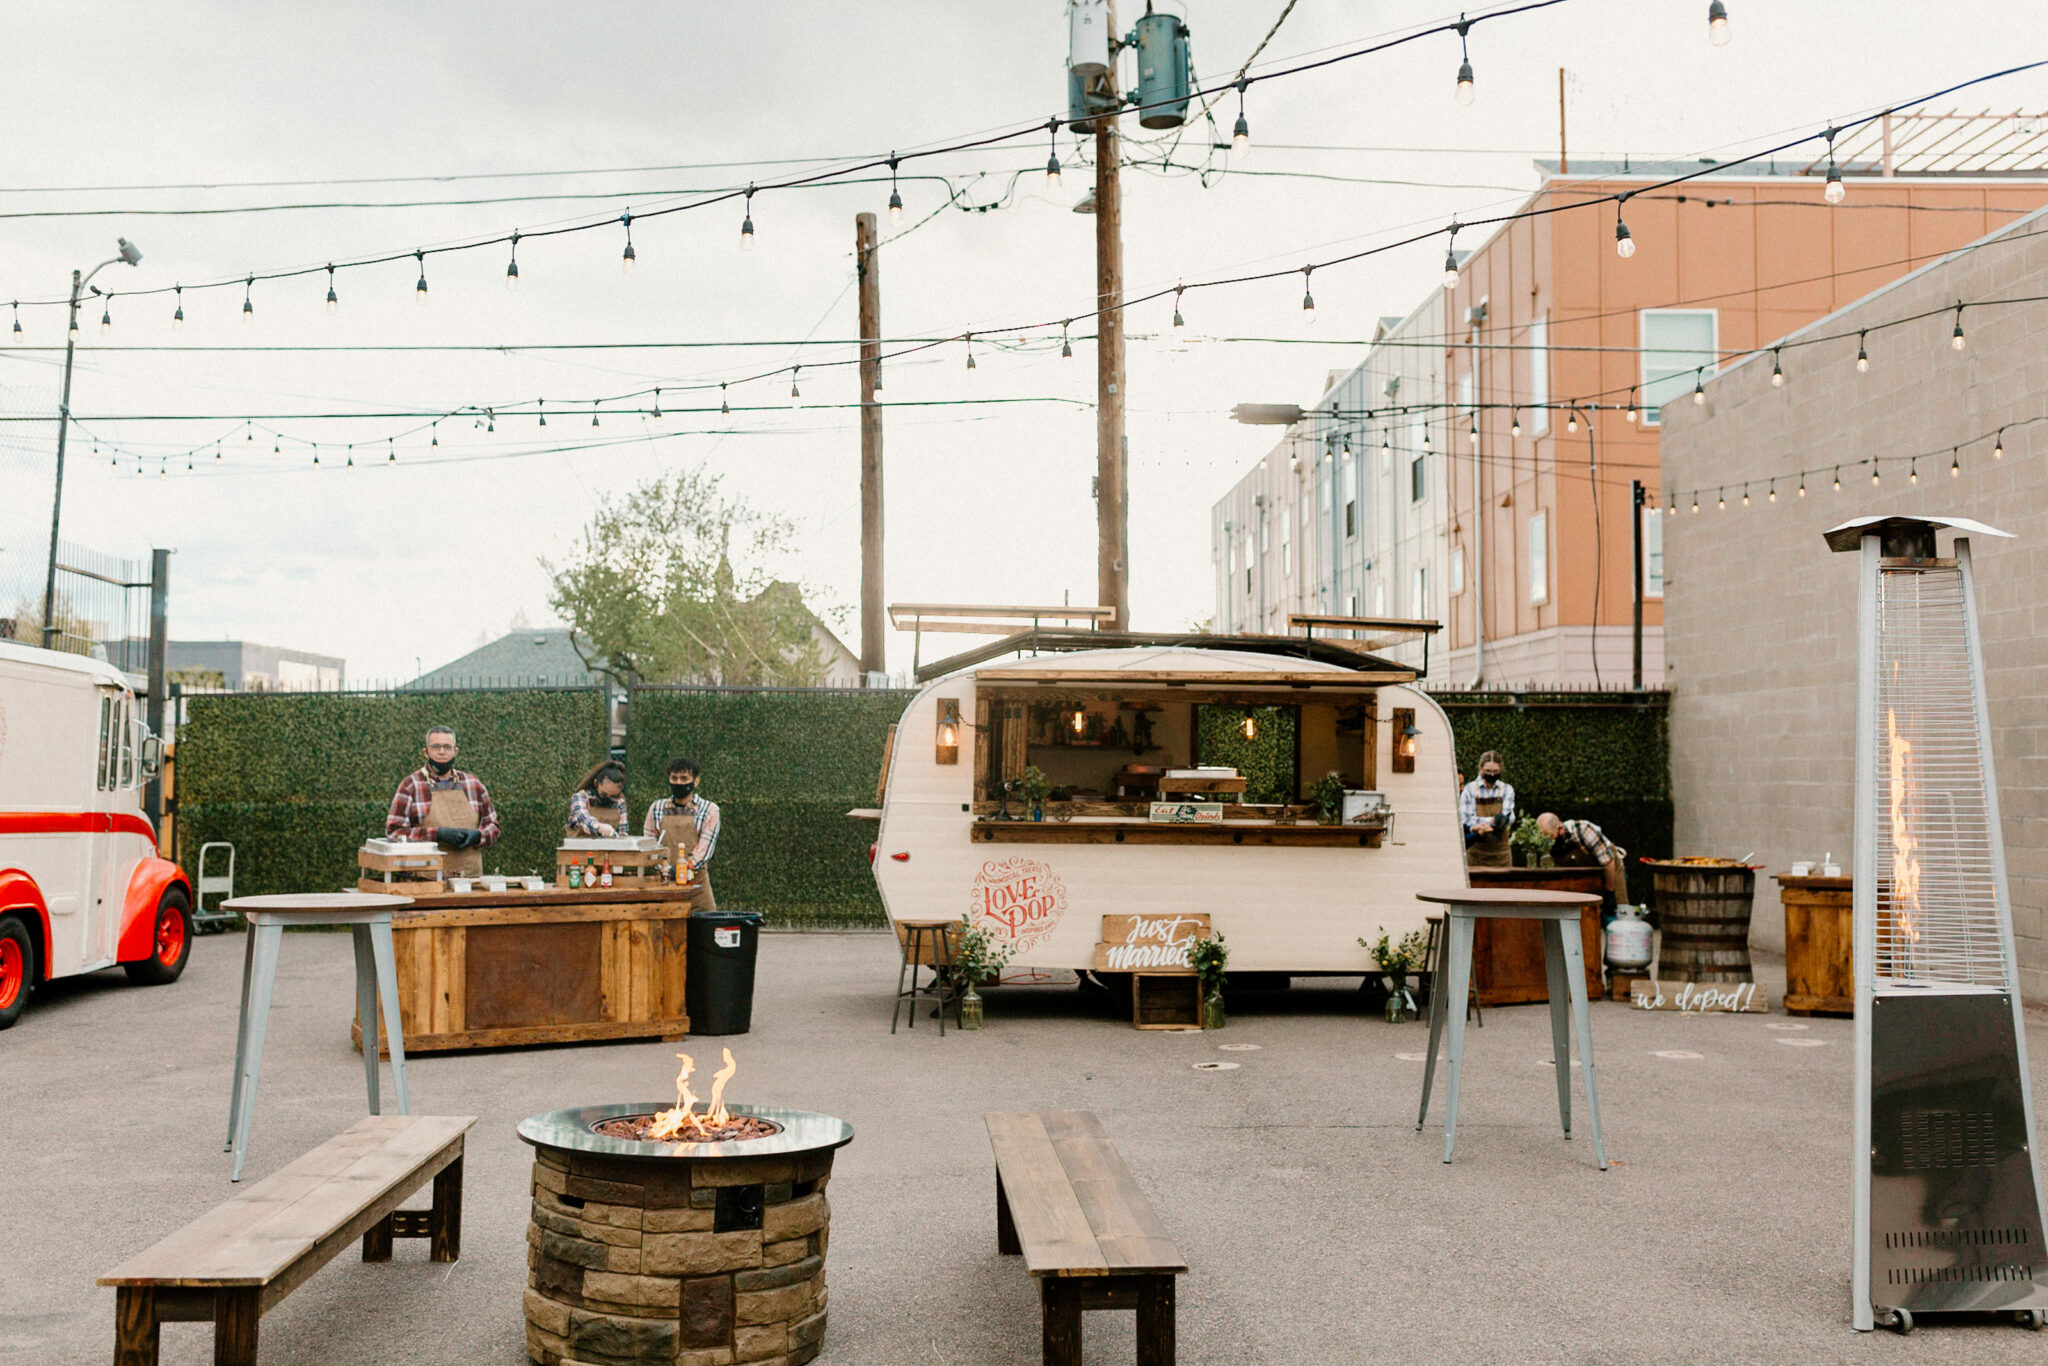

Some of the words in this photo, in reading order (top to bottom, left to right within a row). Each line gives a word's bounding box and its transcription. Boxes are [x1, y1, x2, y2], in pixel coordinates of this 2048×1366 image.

[1155, 806, 1175, 814] Eat
[984, 876, 1040, 917] LOVE
[1001, 894, 1056, 939] POP
[1126, 915, 1203, 945] Just
[1675, 982, 1756, 1012] eloped!
